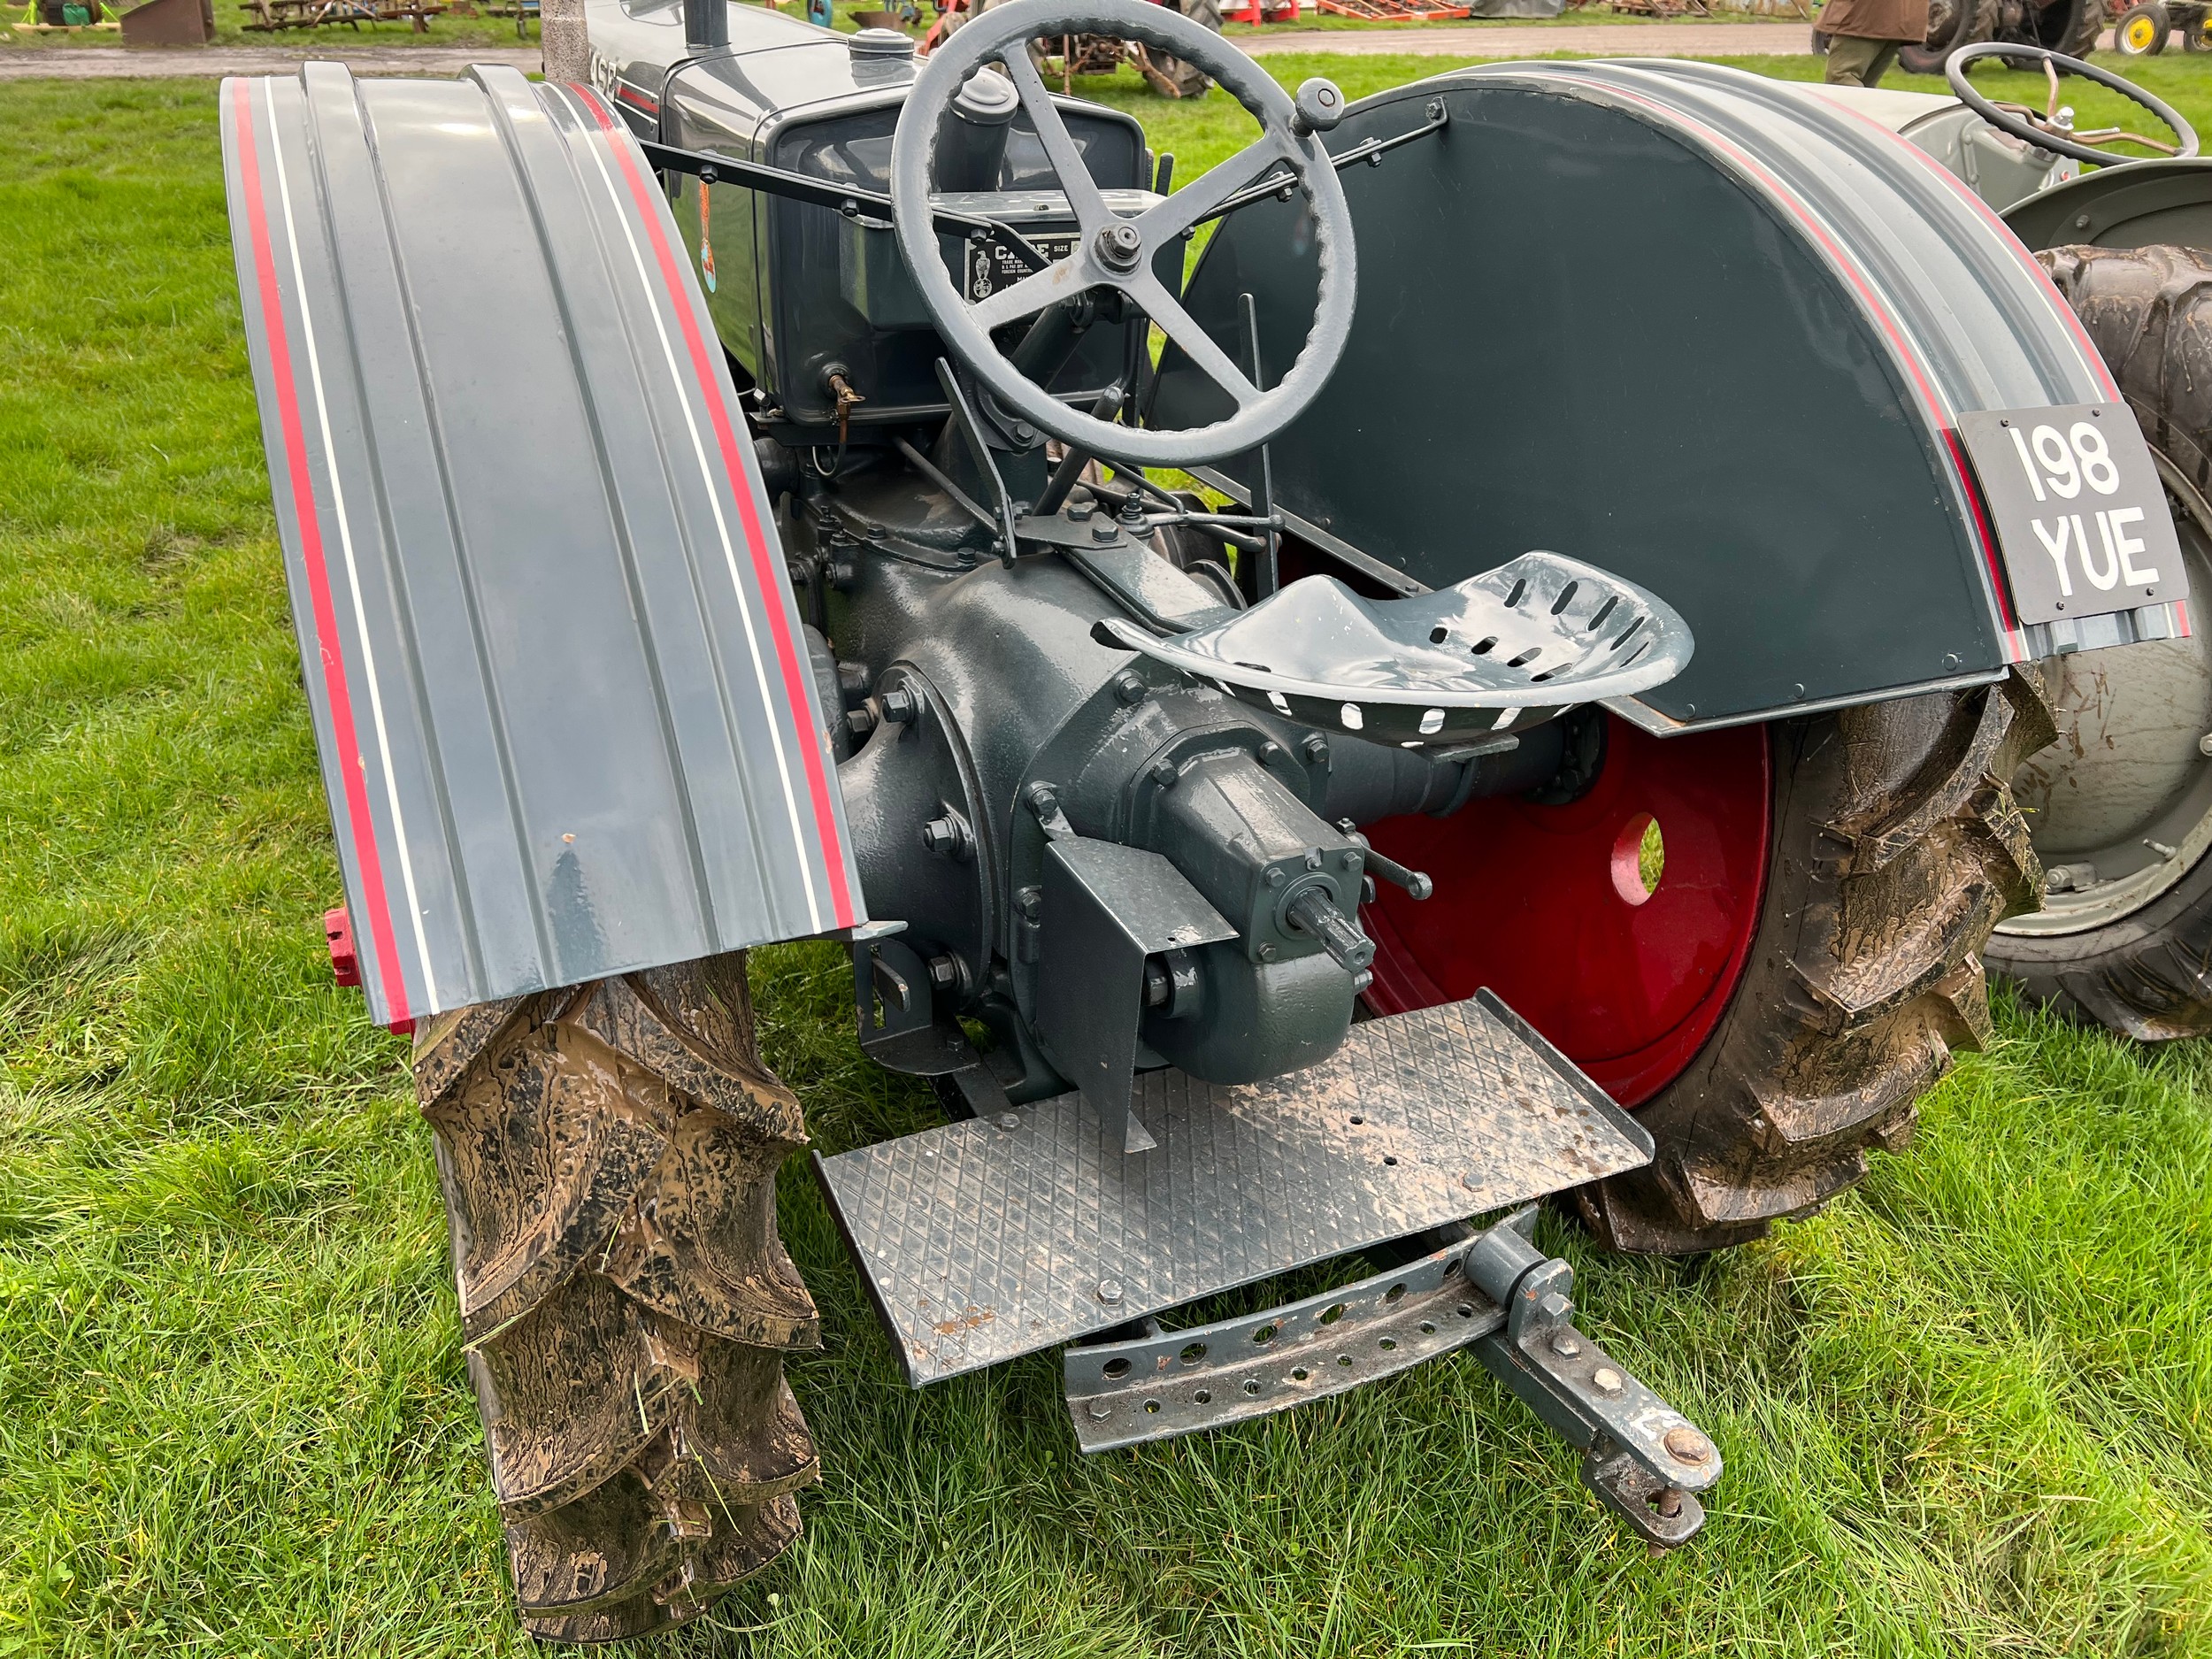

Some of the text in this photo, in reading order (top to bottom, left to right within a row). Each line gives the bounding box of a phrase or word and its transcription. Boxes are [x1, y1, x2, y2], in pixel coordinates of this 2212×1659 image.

[589, 49, 617, 103] ASE
[2008, 422, 2120, 502] 198
[2031, 506, 2160, 596] YUE
